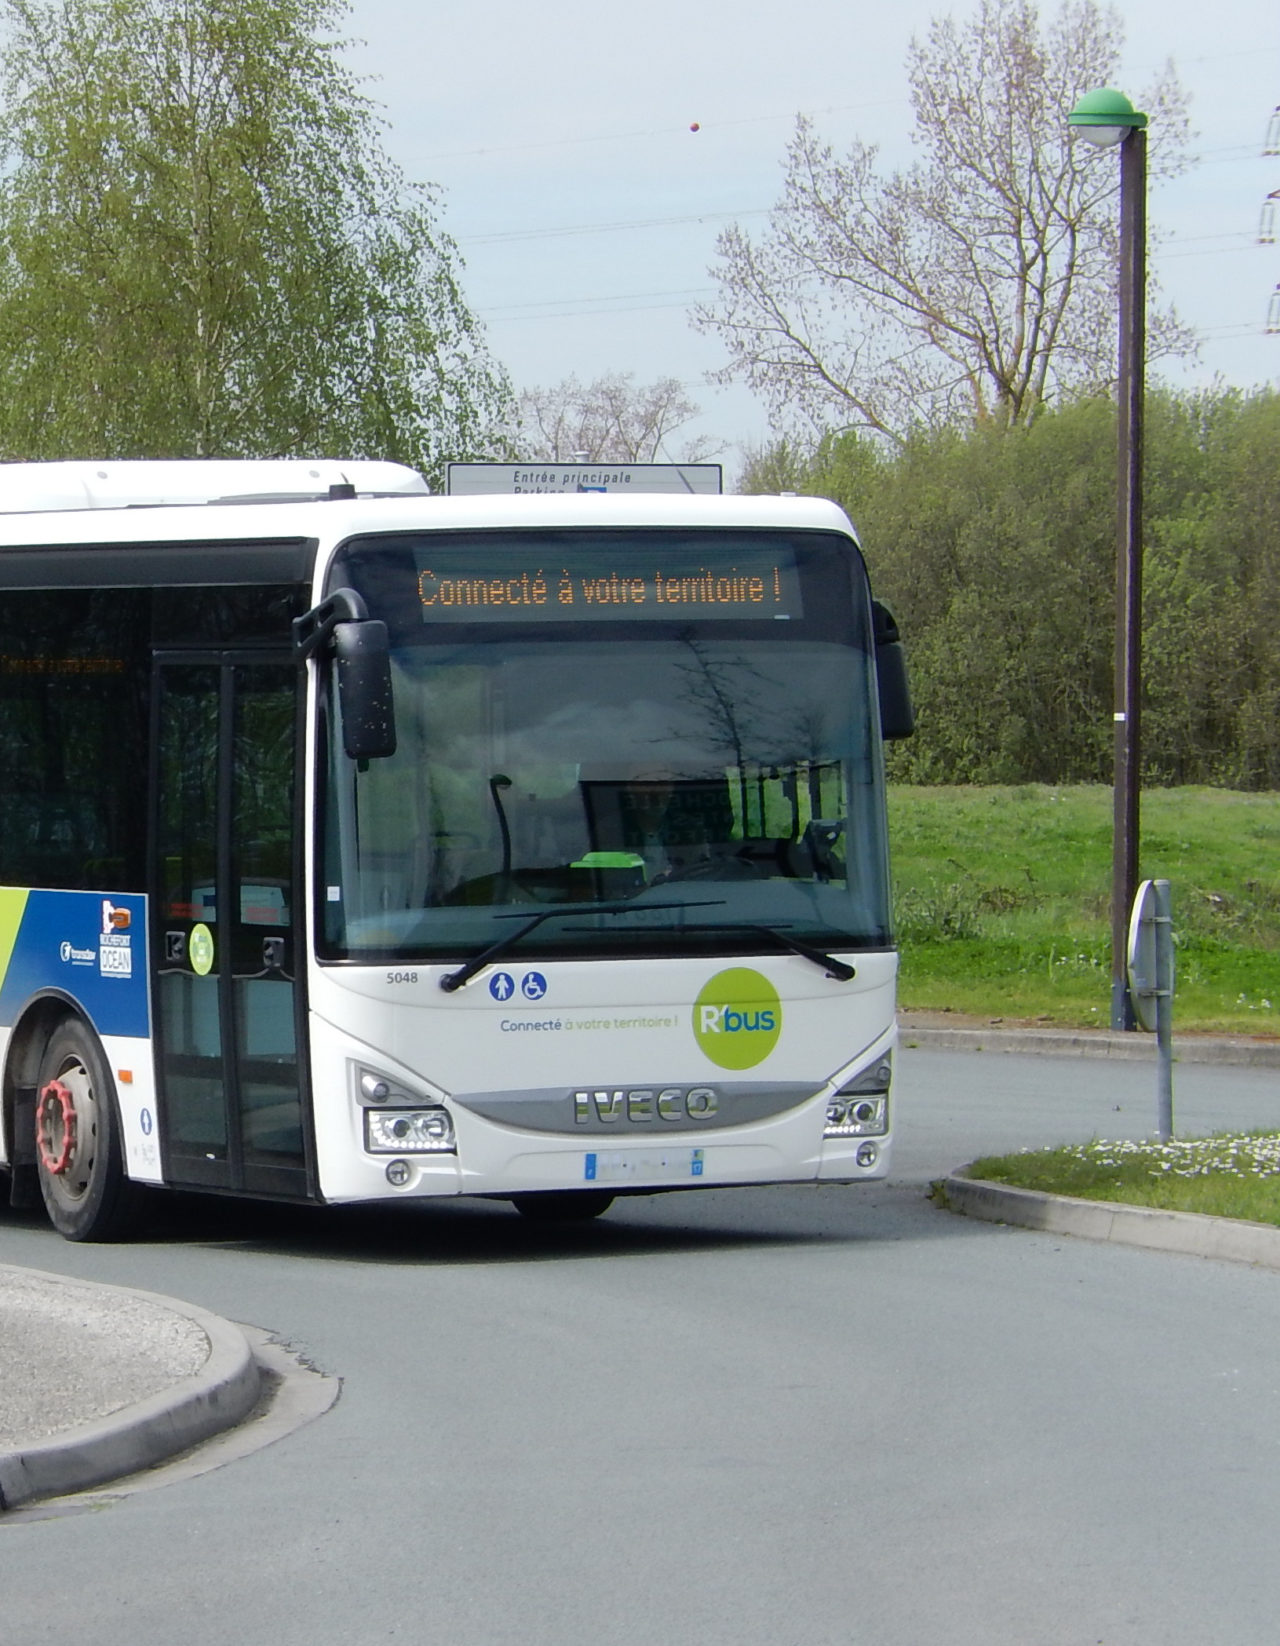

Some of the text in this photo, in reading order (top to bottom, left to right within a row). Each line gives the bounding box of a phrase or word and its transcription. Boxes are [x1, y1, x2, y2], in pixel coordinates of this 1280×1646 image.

[513, 470, 631, 486] Entrée principale
[418, 568, 548, 606] Connecté
[558, 568, 574, 605] à
[581, 571, 647, 604] votre
[654, 567, 765, 604] territoire
[386, 972, 418, 985] 5048
[500, 1018, 562, 1032] Connecté
[565, 1018, 574, 1031] à
[576, 1018, 611, 1031] votre
[613, 1016, 672, 1030] territoire
[574, 1087, 720, 1125] IVECO
